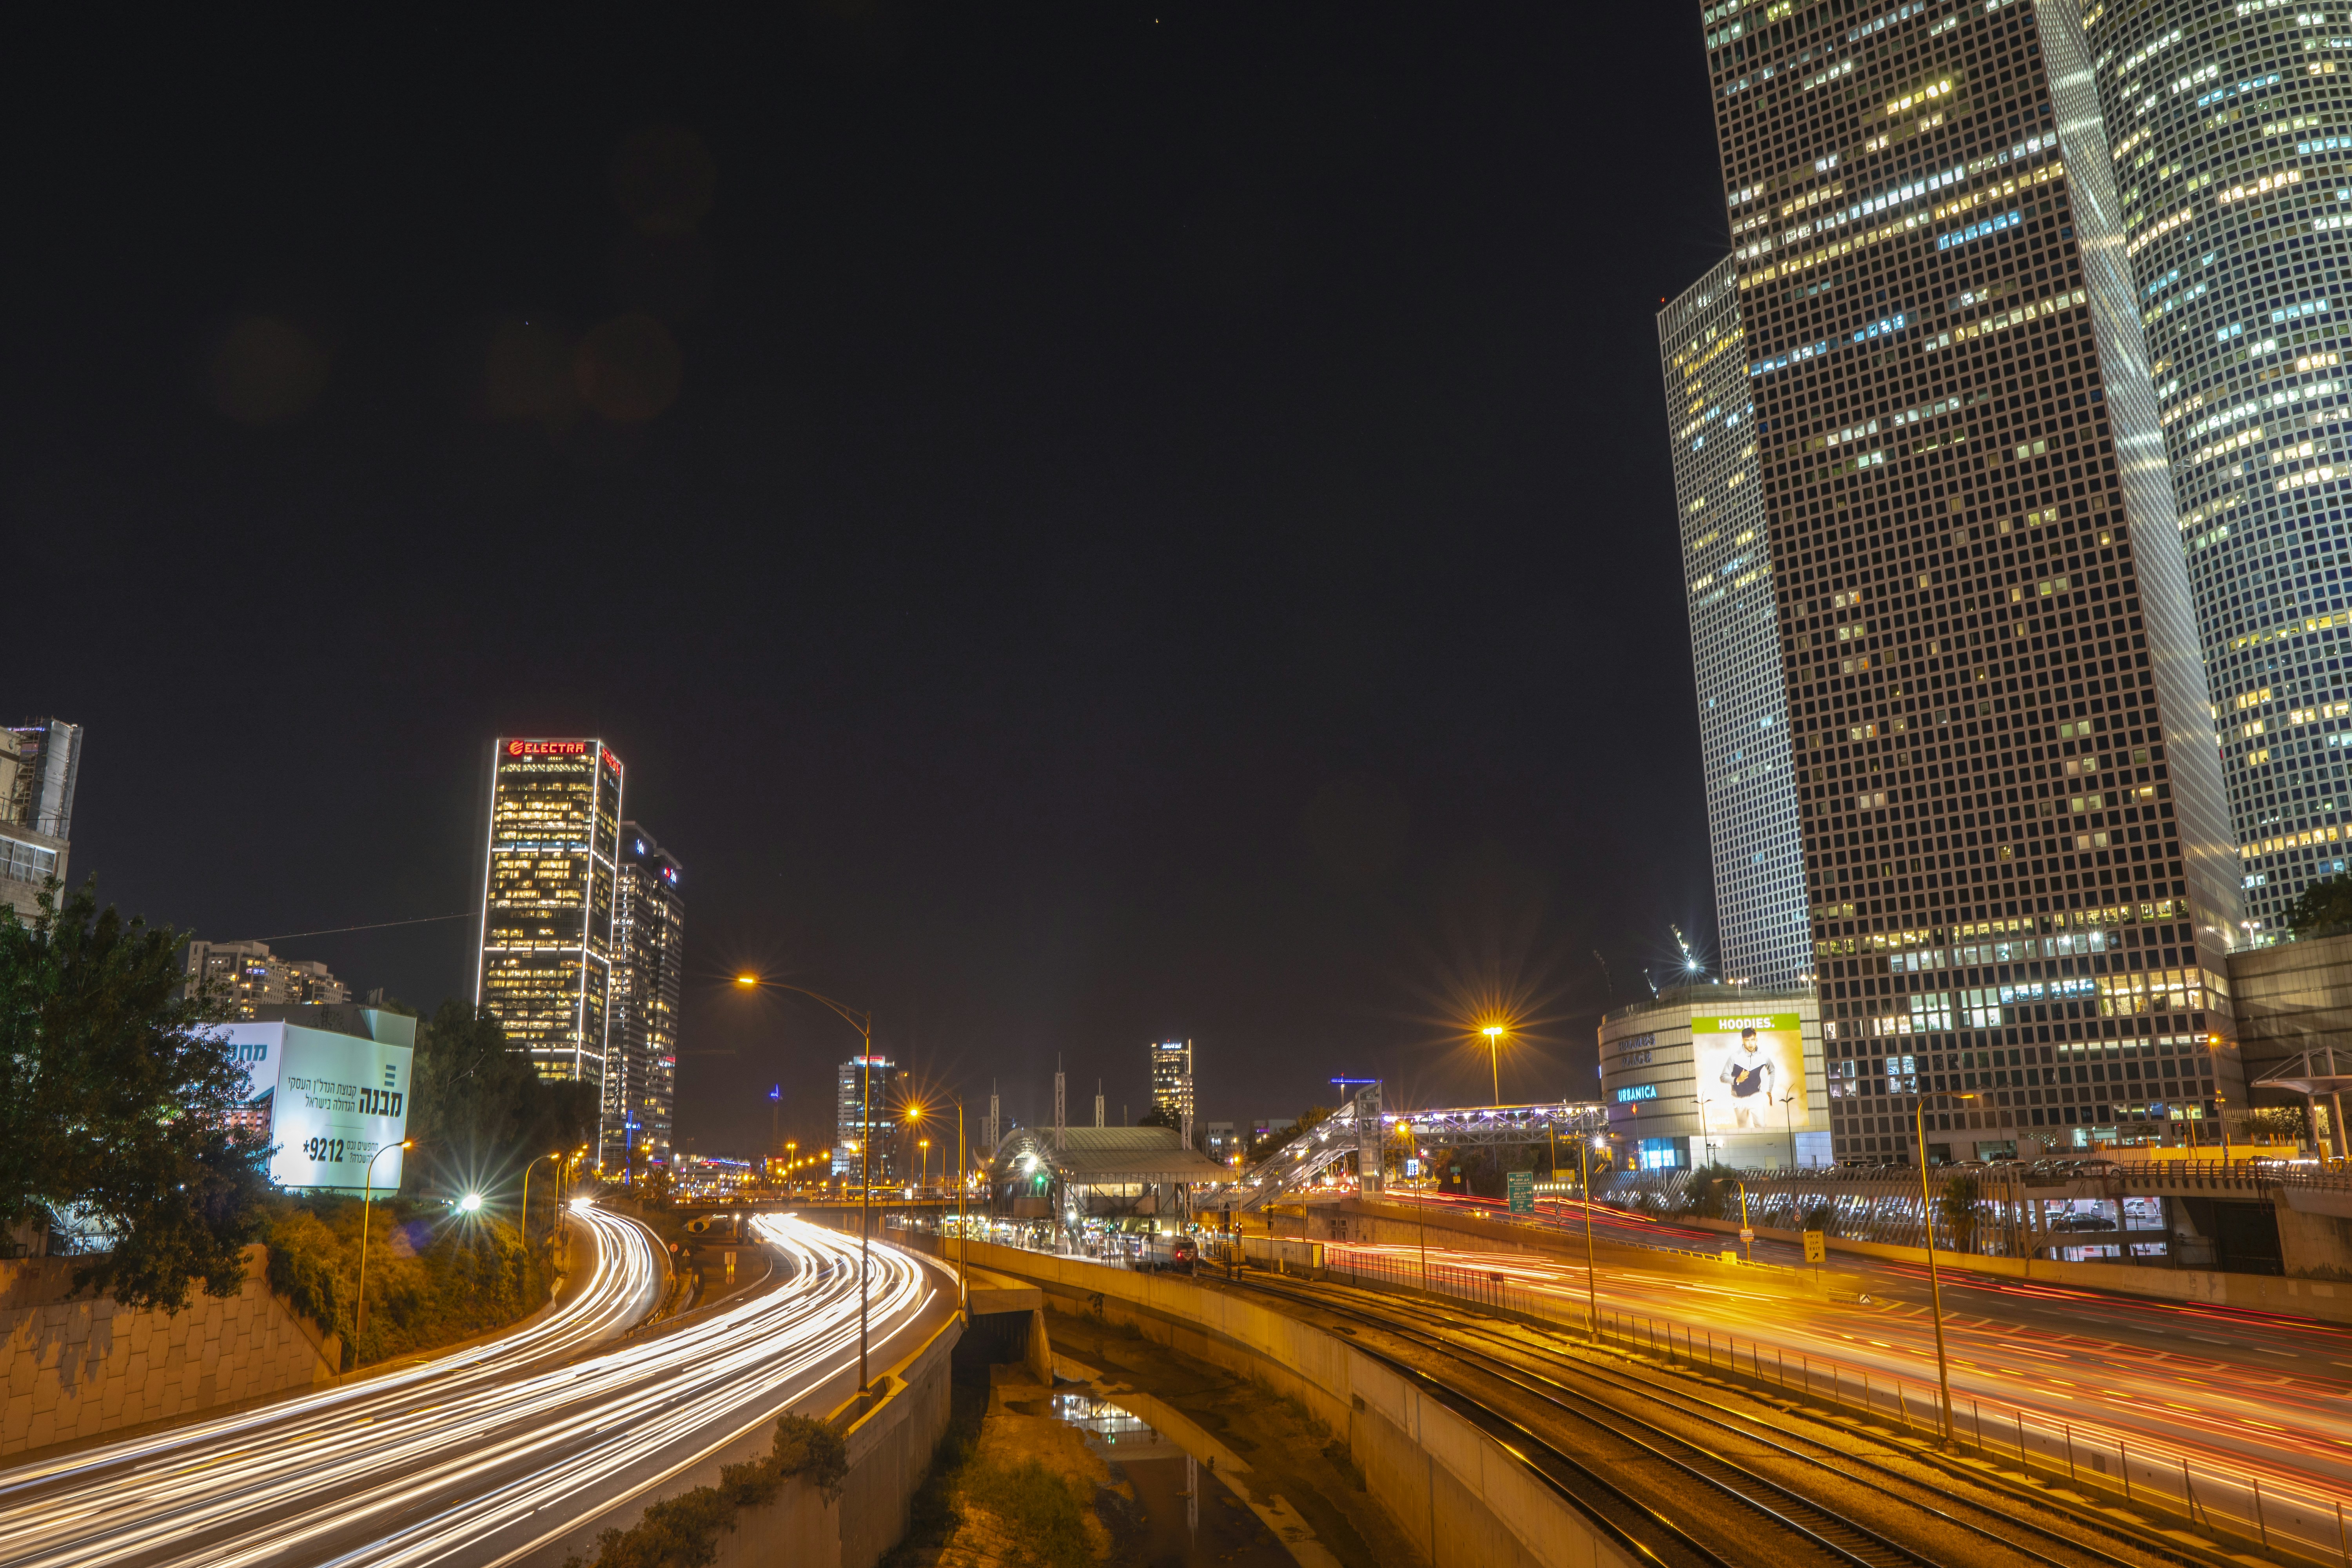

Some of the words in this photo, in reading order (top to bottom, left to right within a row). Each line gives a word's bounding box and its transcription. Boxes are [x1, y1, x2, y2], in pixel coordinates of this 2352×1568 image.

[524, 742, 585, 753] ELECTRA
[1719, 1017, 1775, 1030] HOODIES.
[1618, 1034, 1656, 1052] HOLMES
[1621, 1052, 1653, 1067] PLACE
[288, 1077, 311, 1091] העסקי
[313, 1078, 335, 1094] הנדל"ן
[336, 1083, 357, 1100] קבוצת
[1618, 1085, 1657, 1102] URBANICA
[305, 1094, 331, 1110] בישראל
[333, 1097, 356, 1112] הגדולה
[359, 1087, 403, 1118] מבנה
[347, 1140, 356, 1150] נכס
[357, 1142, 379, 1152] מחפשים
[350, 1152, 373, 1164] להשכרה?
